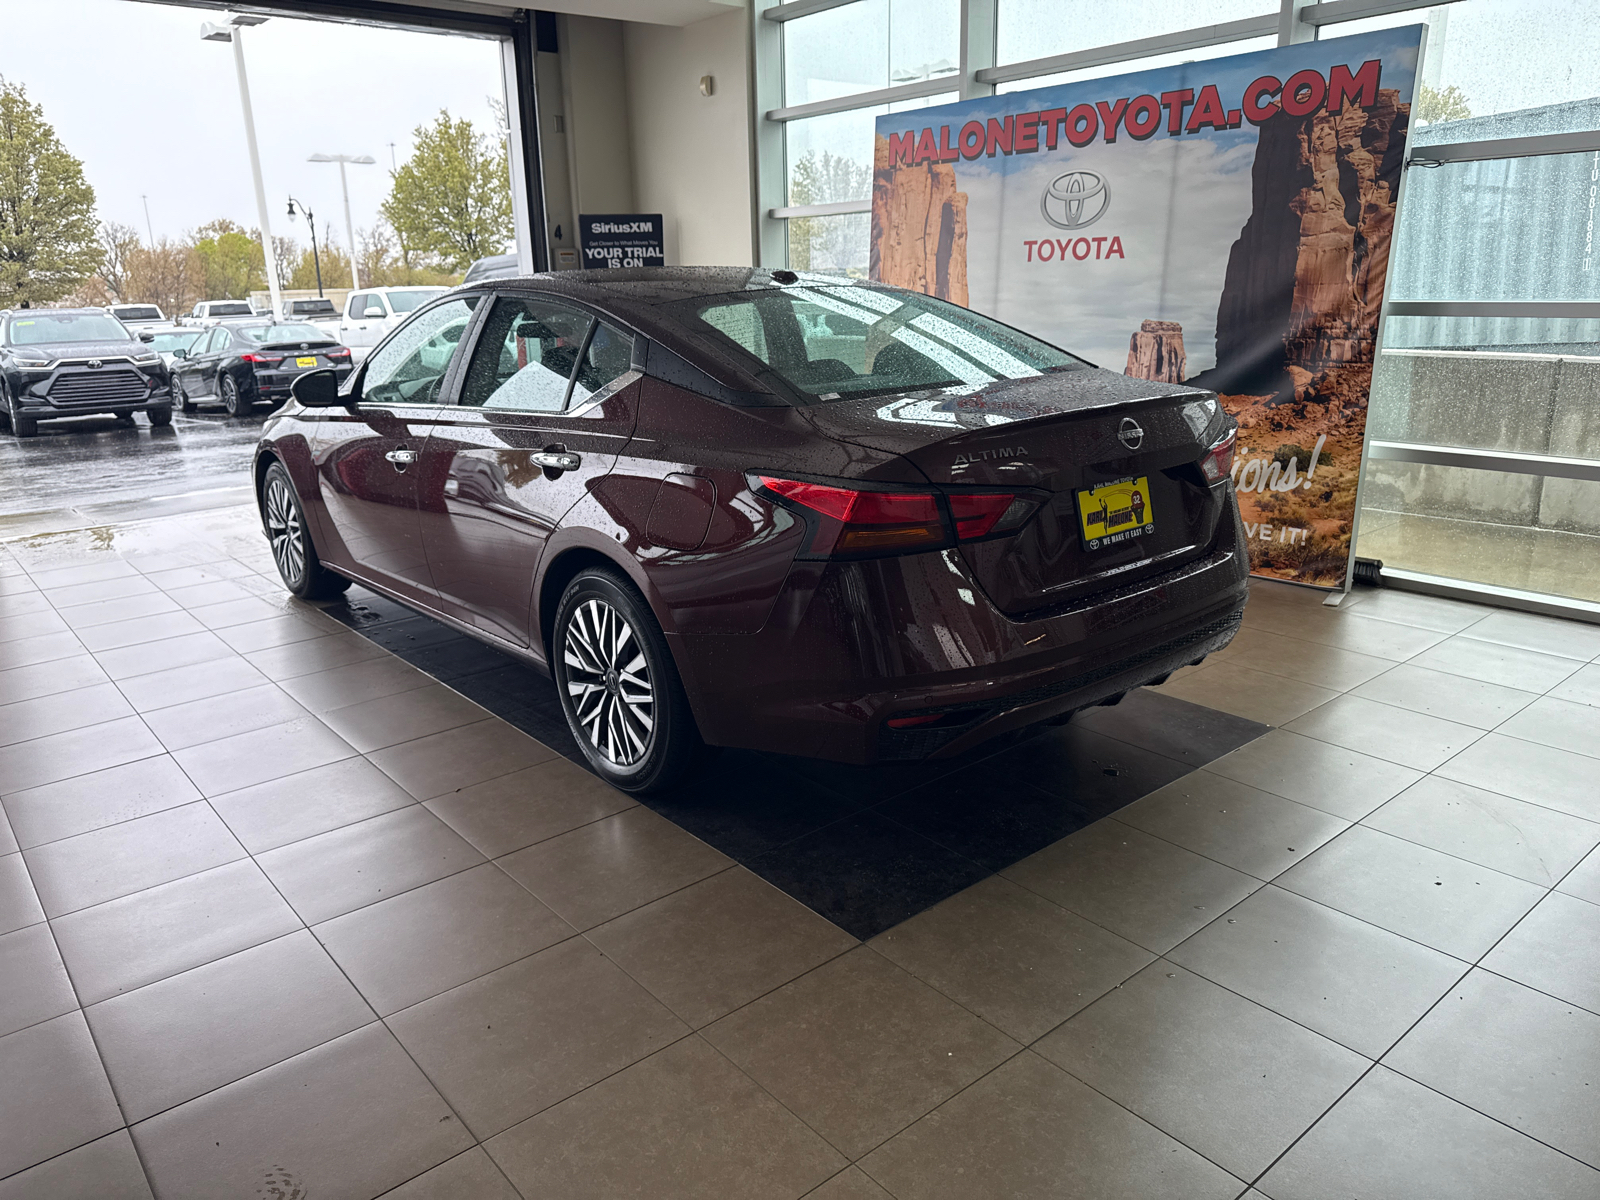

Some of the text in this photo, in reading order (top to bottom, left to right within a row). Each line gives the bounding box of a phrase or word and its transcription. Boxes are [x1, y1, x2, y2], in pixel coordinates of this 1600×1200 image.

[888, 59, 1382, 168] MALONETOYOTA.COM
[591, 222, 653, 233] SiriusXM
[1585, 186, 1597, 254] 081884
[555, 225, 562, 240] 4
[585, 248, 622, 259] YOUR
[625, 247, 663, 257] TRIAL
[1023, 235, 1125, 262] TOYOTA
[608, 258, 643, 268] IS ON
[954, 446, 1029, 465] ALTIMA
[1231, 434, 1326, 493] ions!
[1133, 494, 1141, 504] 32
[1108, 510, 1133, 528] MALONE
[1103, 537, 1111, 546] WE
[1111, 533, 1125, 543] MAKE
[1130, 528, 1142, 537] EASY
[1243, 521, 1307, 546] VE IT!
